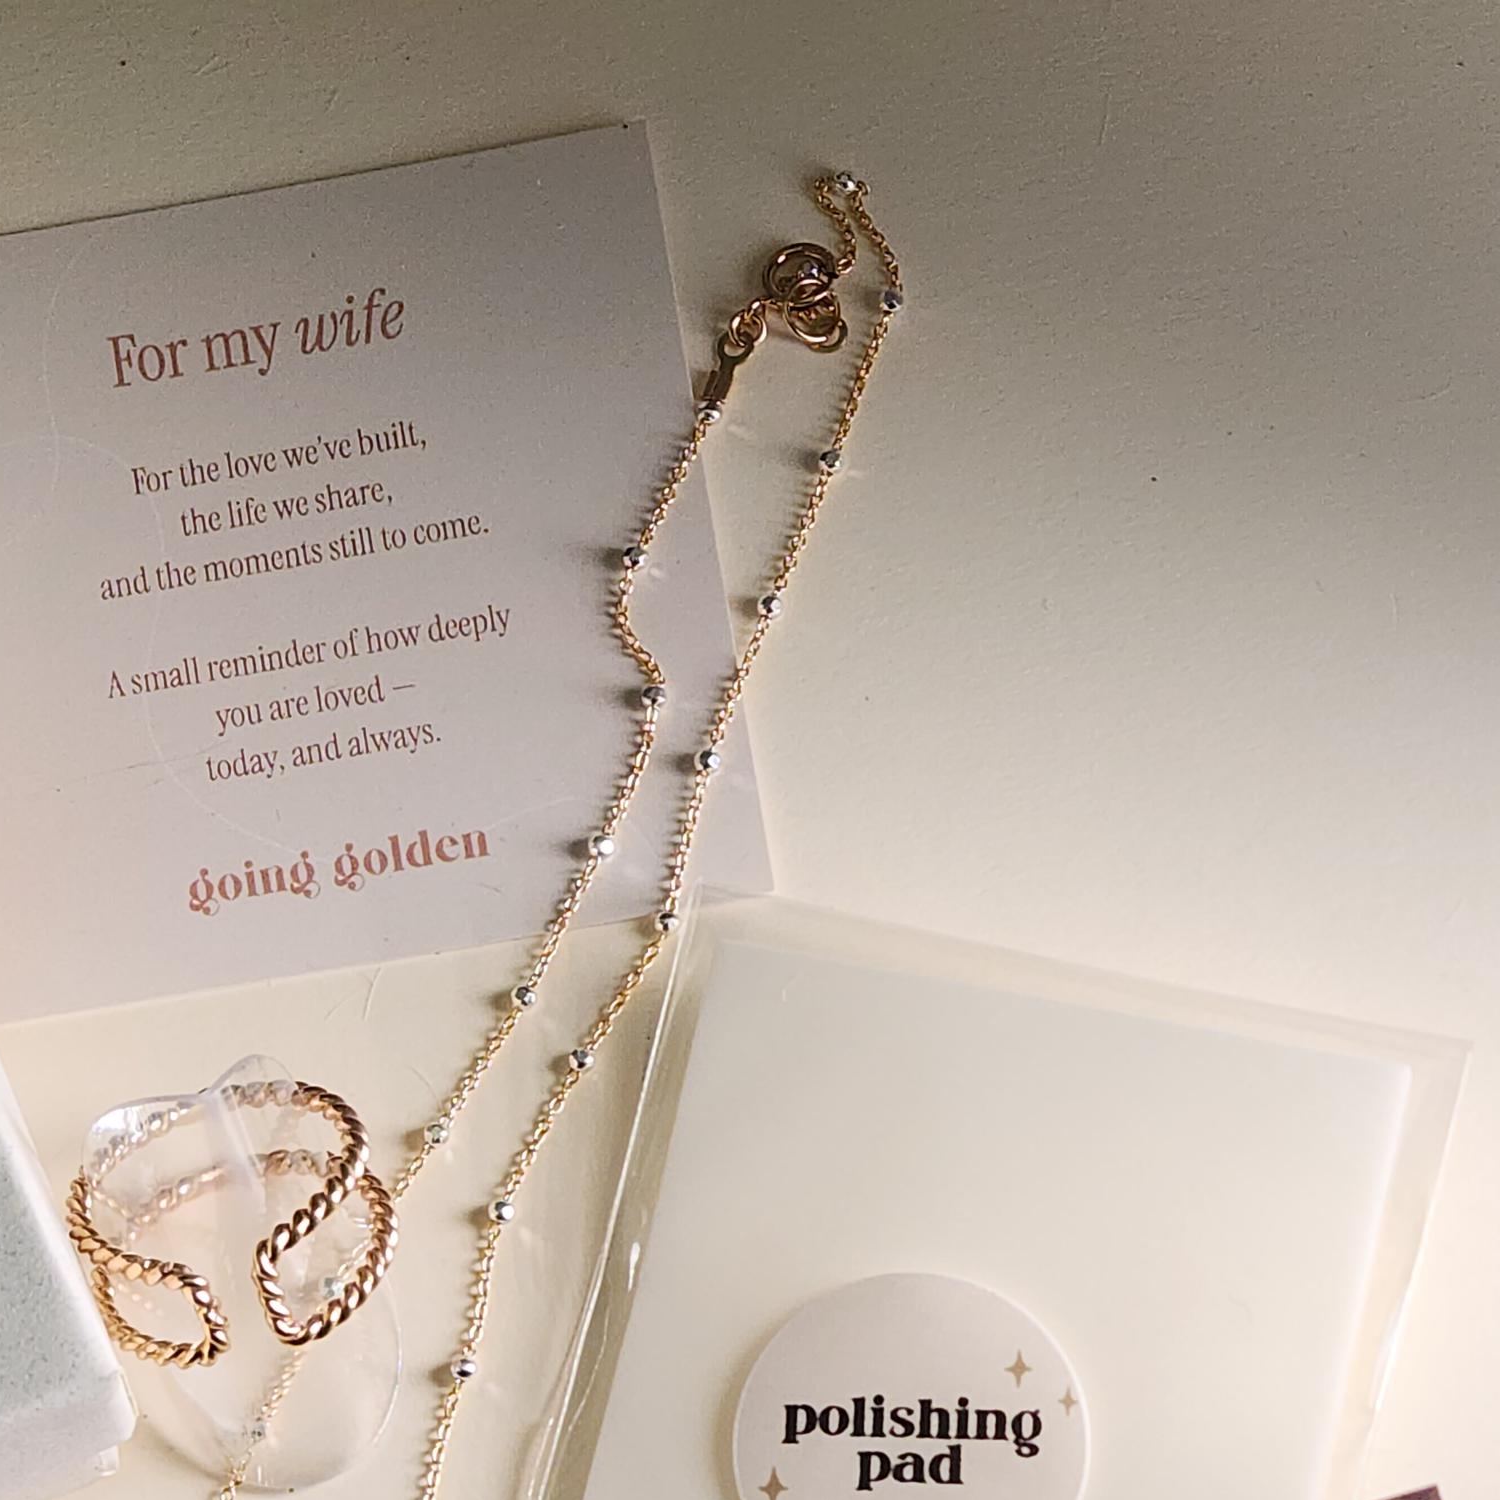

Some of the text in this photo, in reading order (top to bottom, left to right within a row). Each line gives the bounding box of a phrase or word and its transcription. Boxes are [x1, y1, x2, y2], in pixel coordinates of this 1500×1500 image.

[105, 287, 405, 389] For my wife
[130, 420, 427, 496] For the love we've built,
[180, 482, 393, 537] the life we share,
[100, 515, 490, 601] and the moments still to come.
[107, 604, 511, 700] A small reminder of how deeply
[215, 703, 264, 738] you
[268, 695, 310, 722] are
[313, 674, 386, 713] loved
[205, 723, 442, 782] today, and always.
[188, 829, 491, 917] going golden
[781, 1391, 1043, 1458] polishing
[855, 1443, 964, 1491] pad
